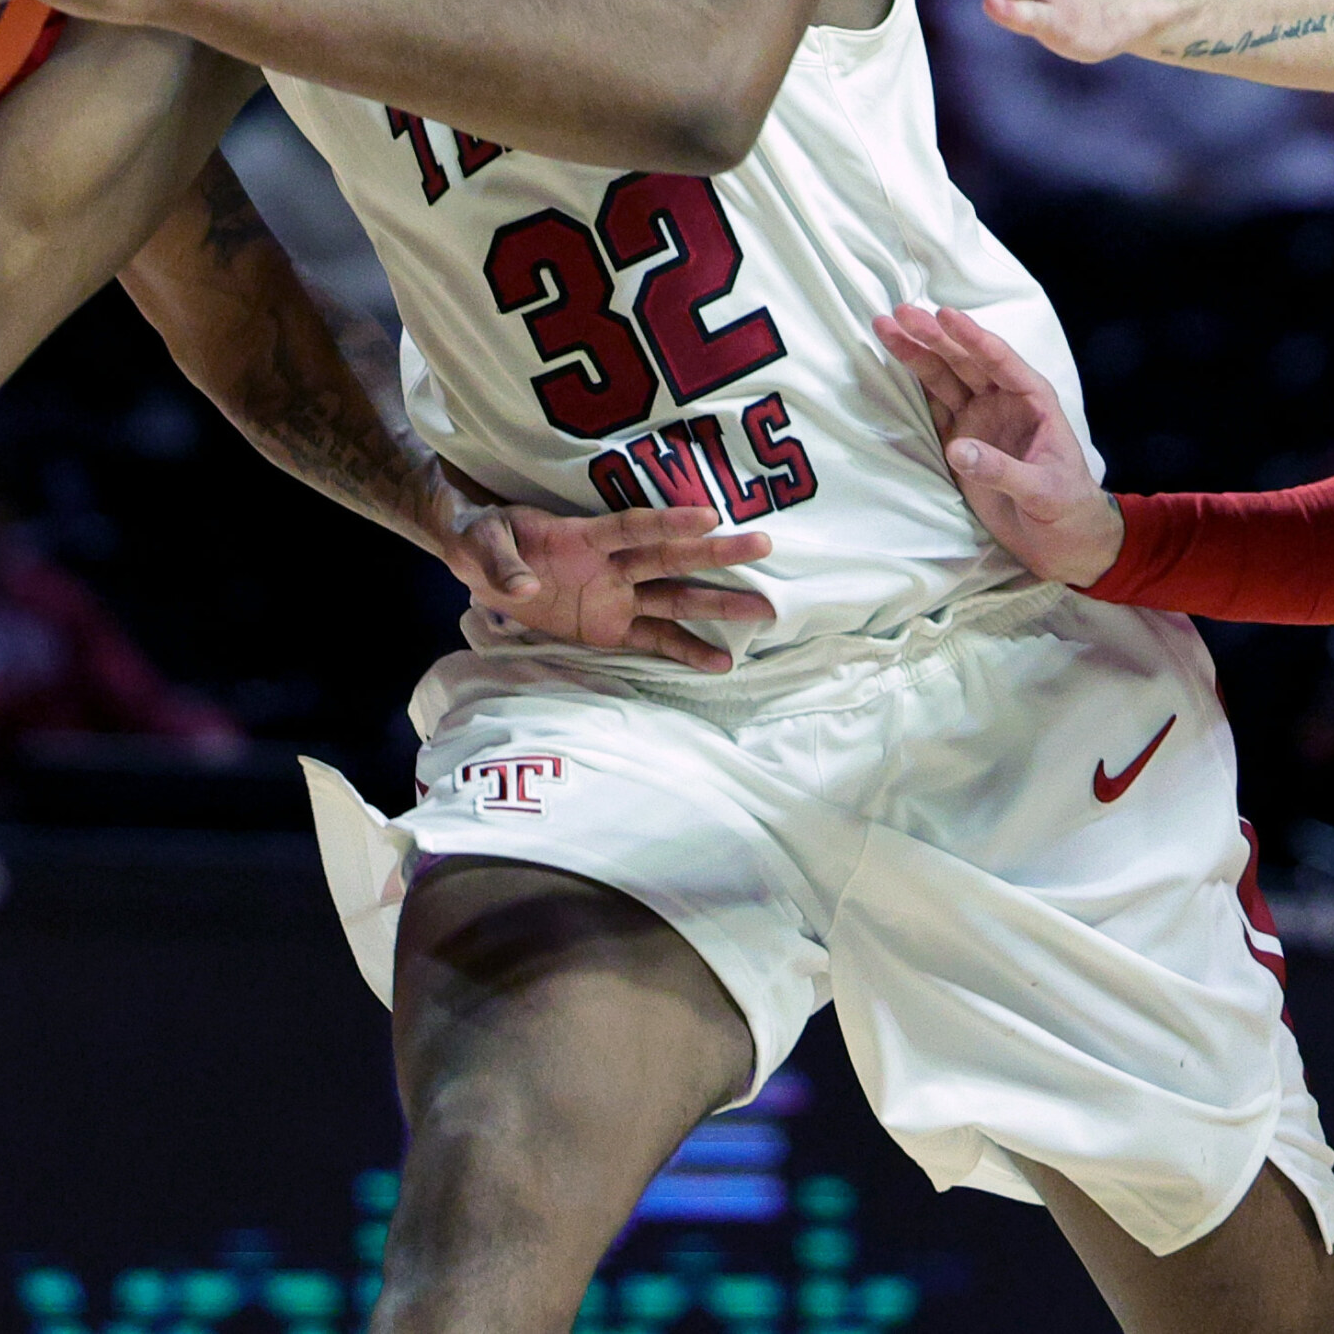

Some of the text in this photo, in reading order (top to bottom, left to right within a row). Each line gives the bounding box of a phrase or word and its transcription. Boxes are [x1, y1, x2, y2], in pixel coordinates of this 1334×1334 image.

[483, 171, 787, 439] 32
[588, 391, 818, 525] OWLS
[454, 753, 565, 816] T
